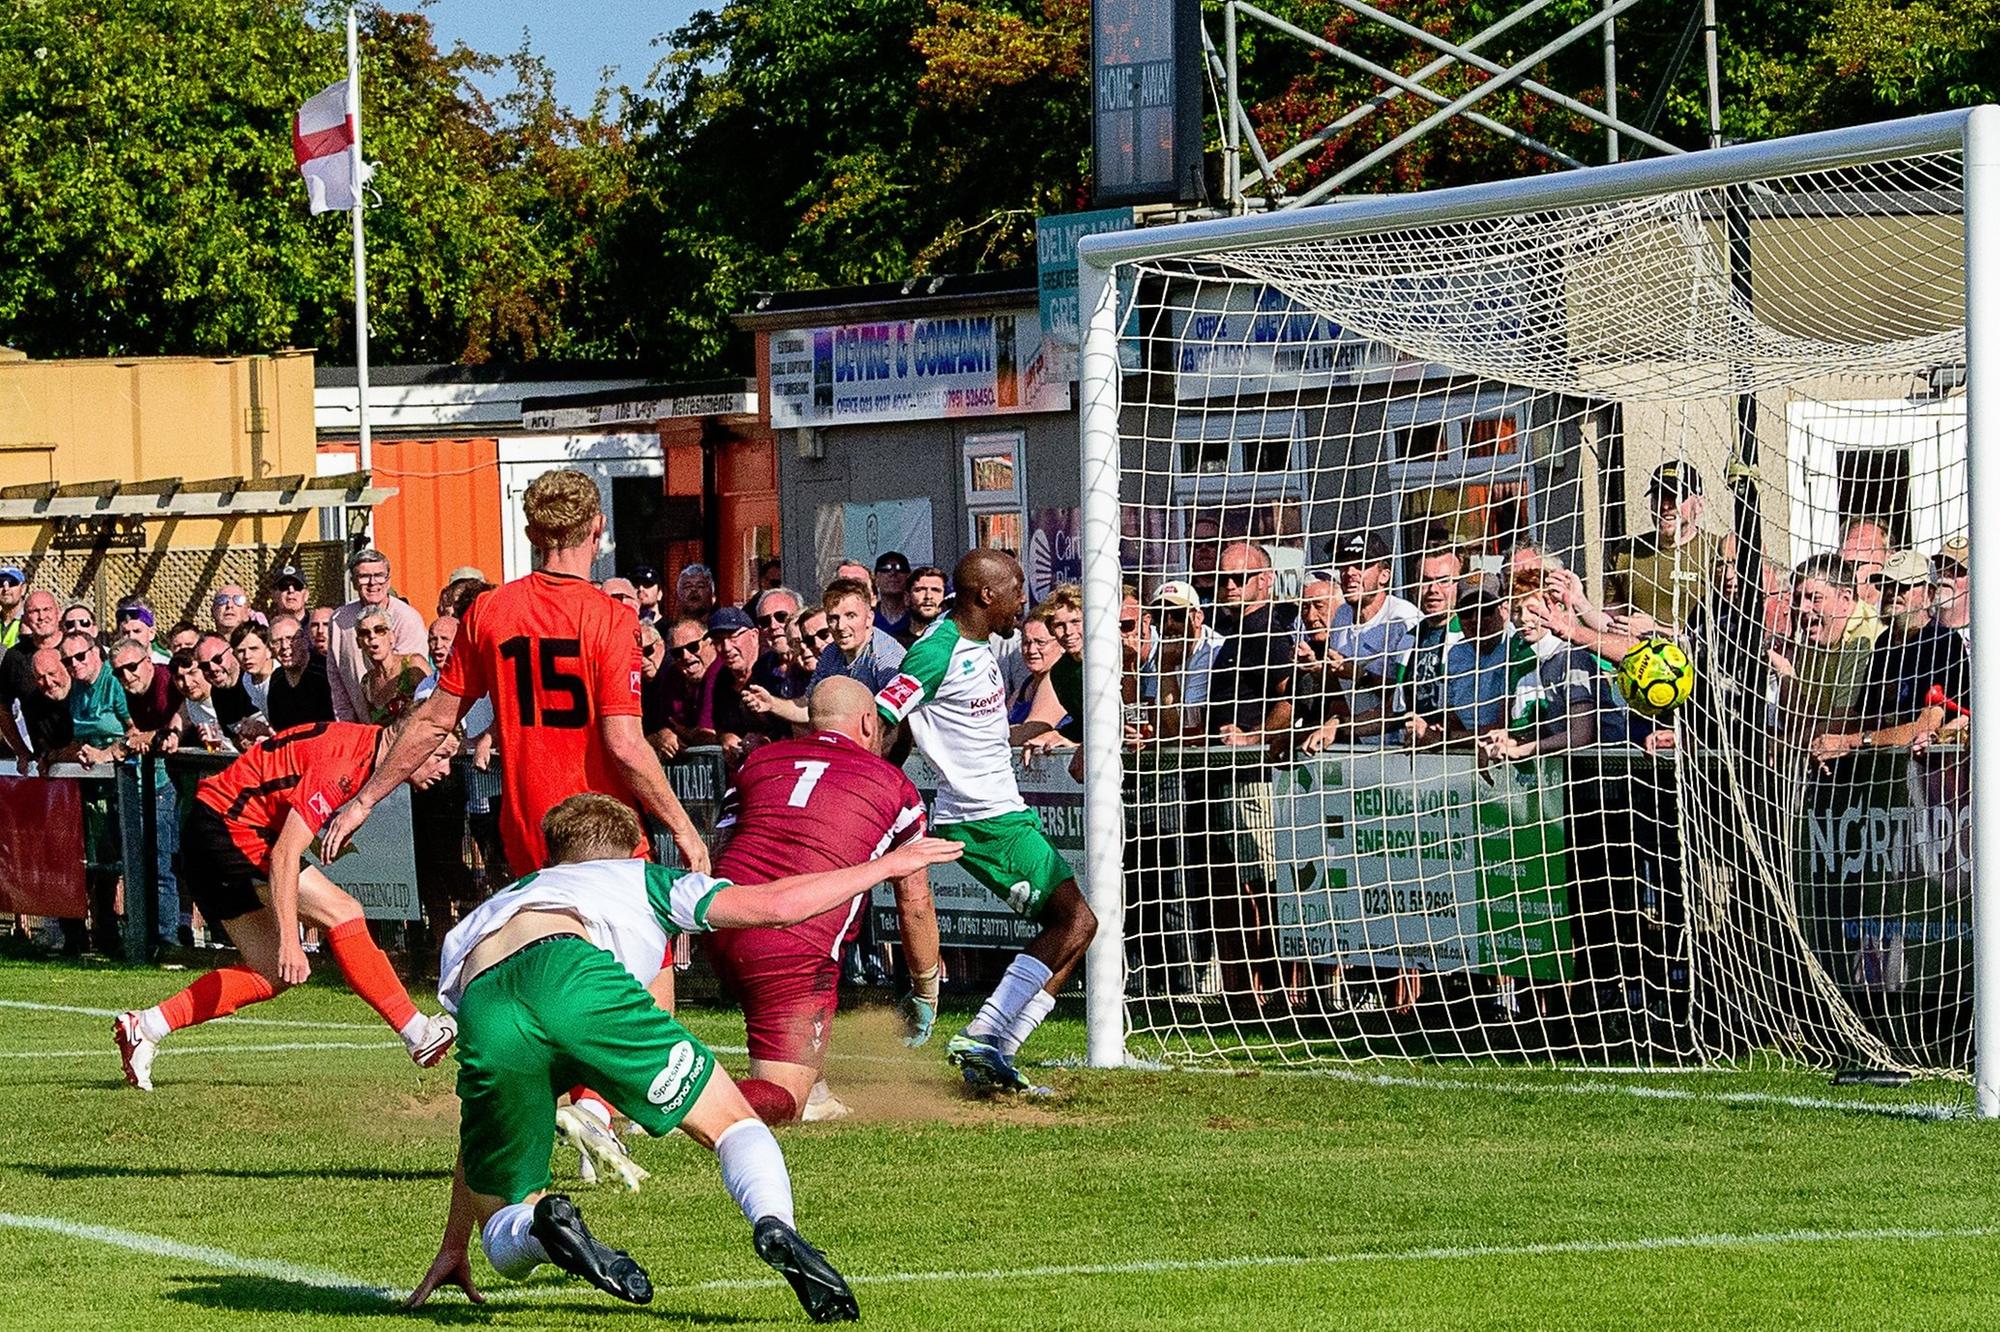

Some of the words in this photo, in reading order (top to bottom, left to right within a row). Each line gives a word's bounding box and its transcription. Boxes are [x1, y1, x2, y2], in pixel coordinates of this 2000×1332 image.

[1100, 66, 1133, 109] HOME
[1141, 62, 1171, 105] AWAY
[1050, 296, 1079, 333] GRE
[1196, 315, 1227, 339] OFFICE
[835, 324, 890, 382] DEVINE
[896, 322, 909, 380] &
[914, 315, 993, 376] COMPANY
[499, 635, 590, 729] 15
[674, 764, 714, 800] TRADE
[788, 761, 831, 808] 7
[1354, 787, 1414, 817] REDUCE
[1420, 789, 1460, 818] YOUR
[1355, 829, 1416, 858] ENERGY
[1421, 830, 1466, 860] BILLS!
[934, 882, 960, 898] General
[1013, 920, 1037, 938] Office
[1281, 903, 1350, 933] CARDINAL
[1283, 936, 1325, 958] ENERGY
[1329, 938, 1350, 959] LTD
[653, 1047, 688, 1098] Specsavers
[661, 1081, 691, 1114] Bognor
